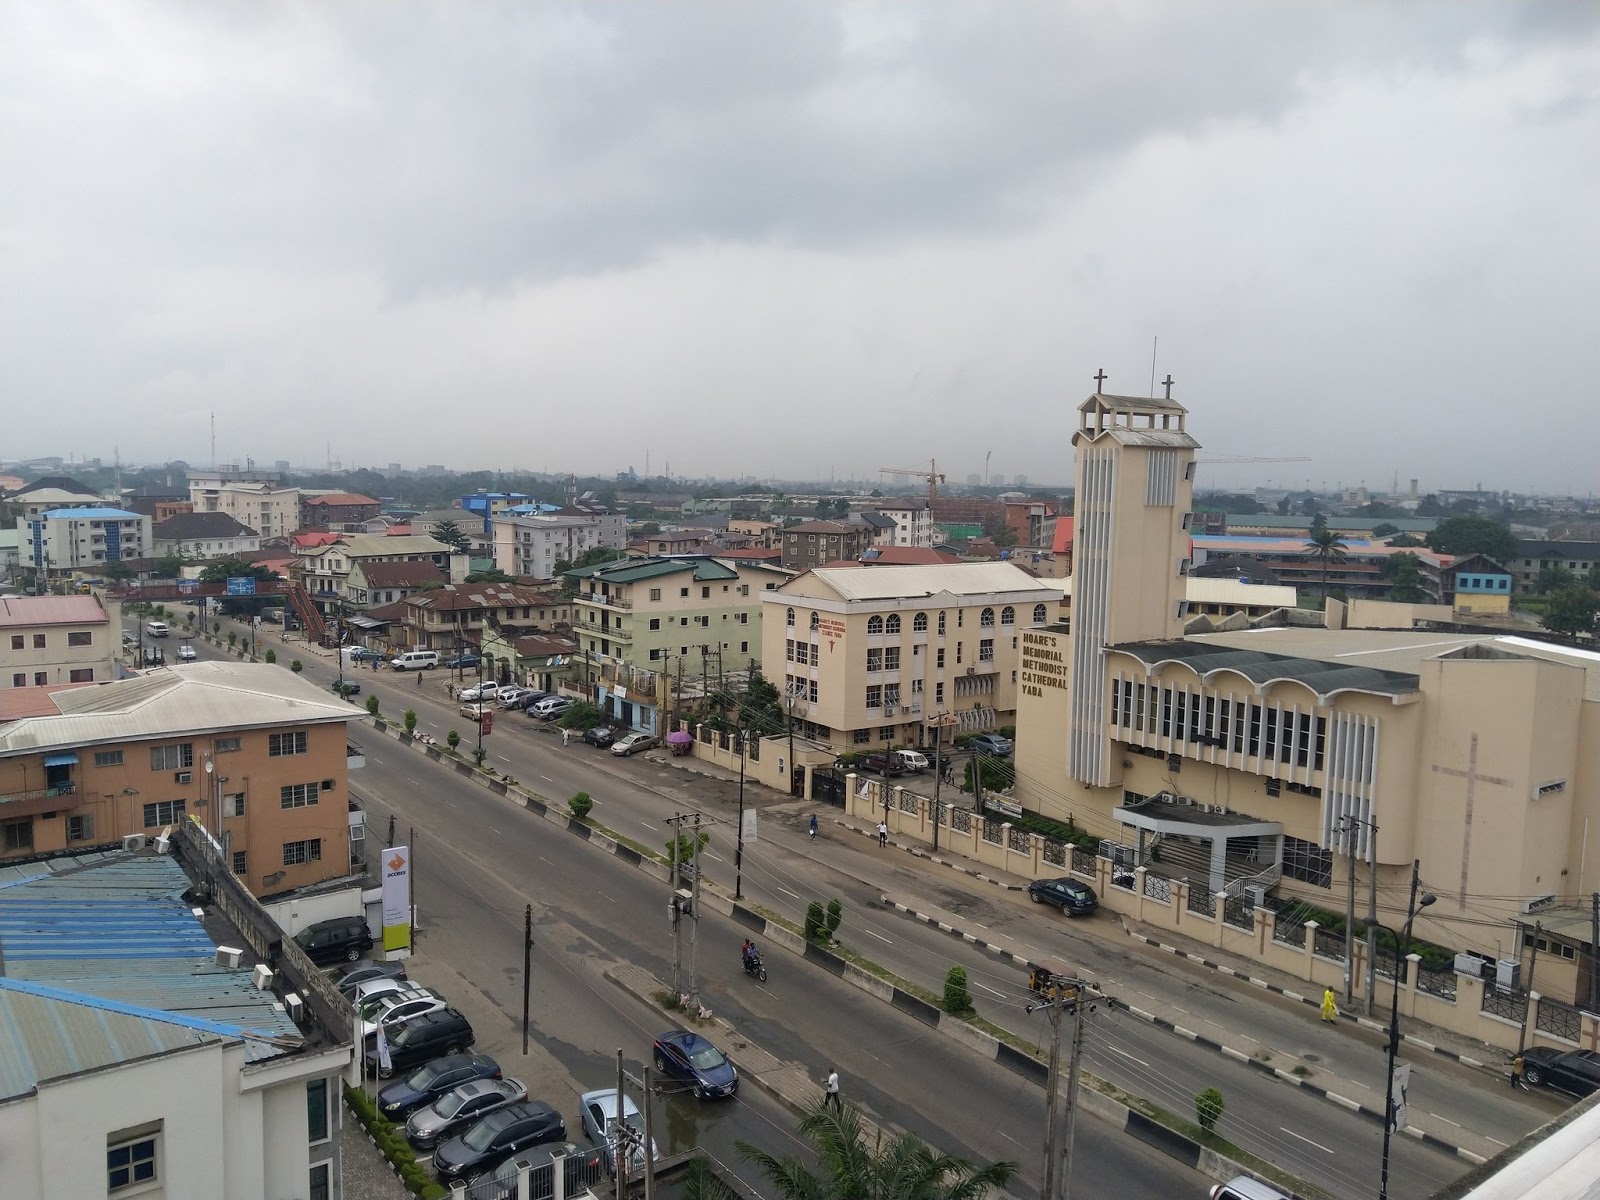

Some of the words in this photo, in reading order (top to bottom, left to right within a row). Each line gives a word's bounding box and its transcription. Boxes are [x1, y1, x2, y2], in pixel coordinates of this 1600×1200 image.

[1023, 633, 1057, 647] HOARE'S
[1023, 646, 1063, 662] MEMORIAL
[1022, 659, 1068, 676] METHODIST
[1022, 672, 1068, 690] CATHEDRAL
[1022, 684, 1043, 697] YABA
